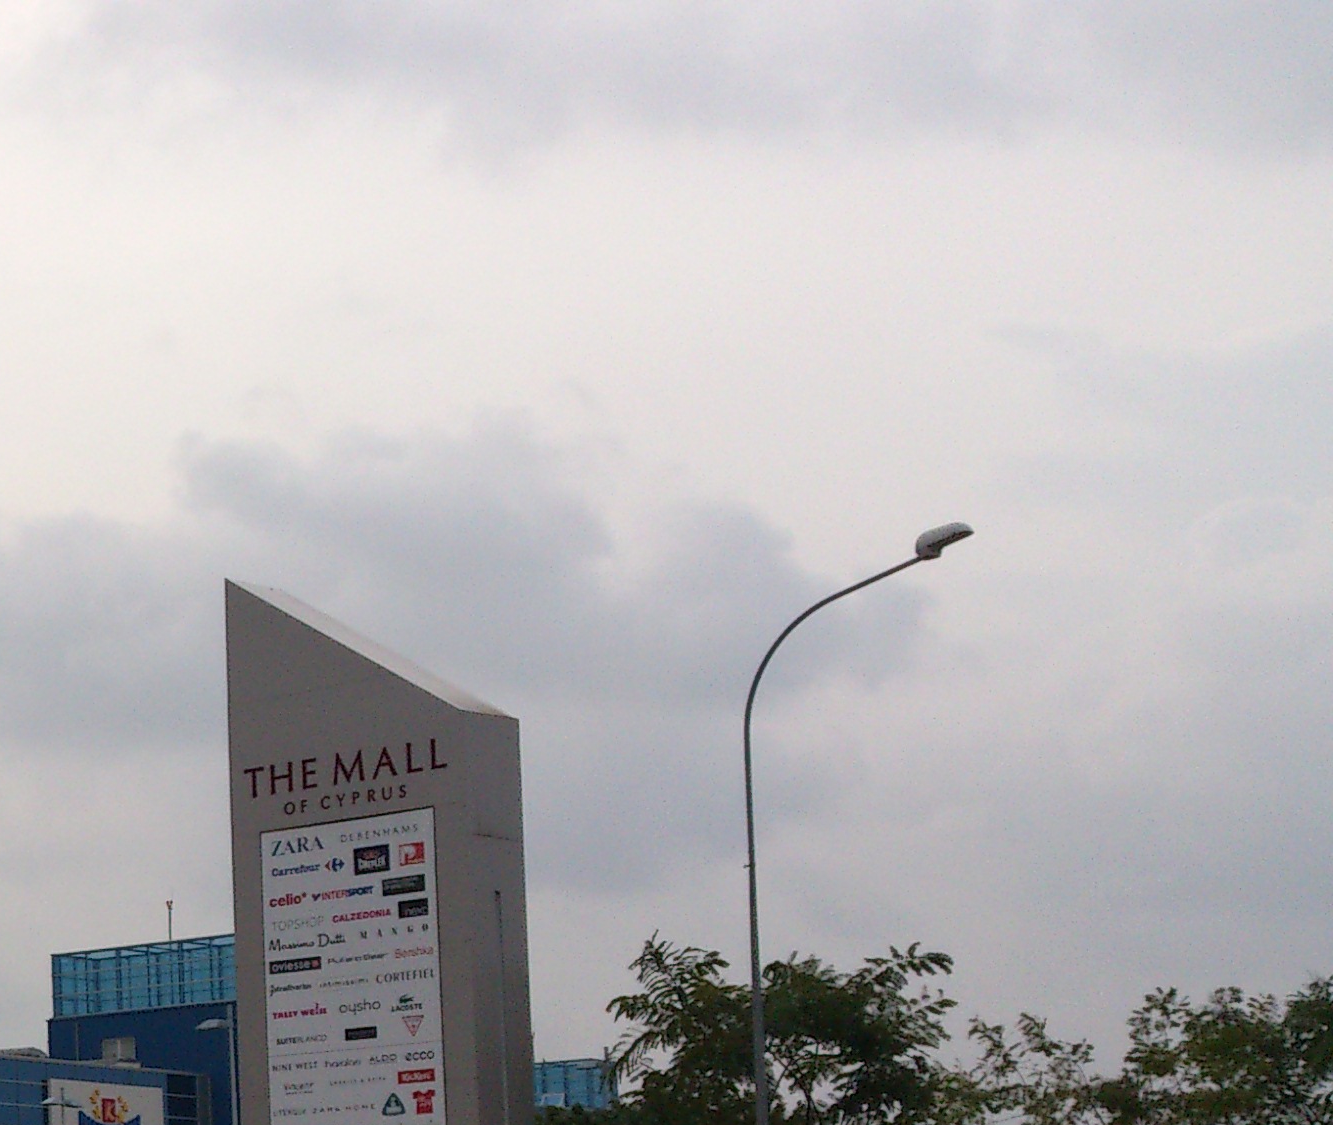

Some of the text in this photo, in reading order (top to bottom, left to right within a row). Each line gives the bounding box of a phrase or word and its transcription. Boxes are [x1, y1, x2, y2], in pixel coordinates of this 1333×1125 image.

[244, 738, 448, 799] THE MALL
[284, 785, 407, 815] OF CYPRUS
[341, 824, 418, 843] DEBENHAMS
[271, 836, 325, 856] ZARA
[271, 863, 321, 877] Carrefour
[321, 886, 374, 901] INTERSPORT
[332, 908, 392, 923] CALZEDONIA
[339, 999, 382, 1015] oysho
[391, 1002, 423, 1013] LACOSTE
